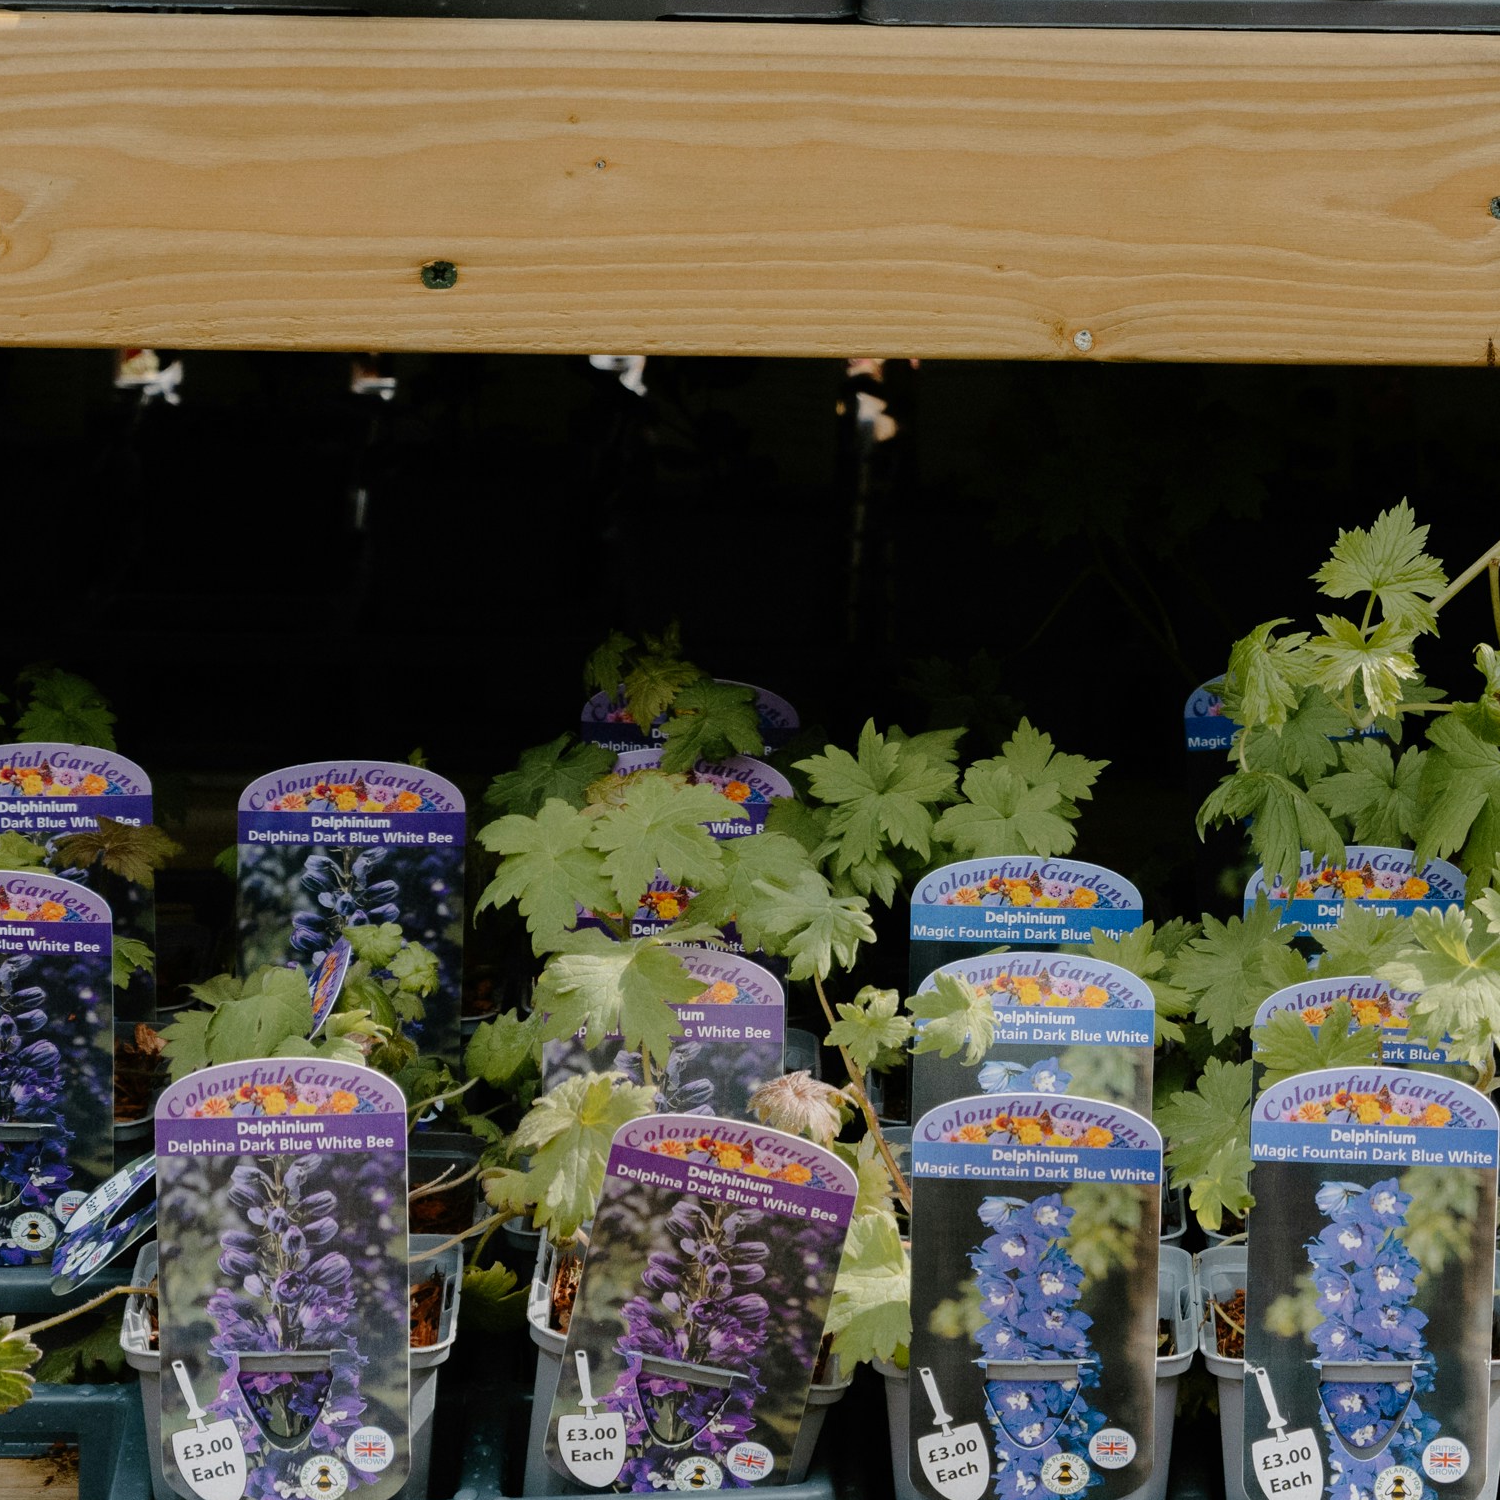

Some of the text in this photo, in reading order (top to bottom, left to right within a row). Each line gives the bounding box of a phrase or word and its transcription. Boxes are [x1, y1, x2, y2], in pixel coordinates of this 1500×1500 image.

[5, 879, 100, 922] Gardens
[27, 940, 70, 952] White
[74, 942, 100, 953] Bee
[1263, 1075, 1487, 1128] Colourful Gardens
[1330, 1129, 1417, 1146] Delphinium
[1253, 1144, 1493, 1164] Magic Fountain Dark Blue White
[1262, 1446, 1312, 1471] £3.00
[1270, 1471, 1313, 1494] Each
